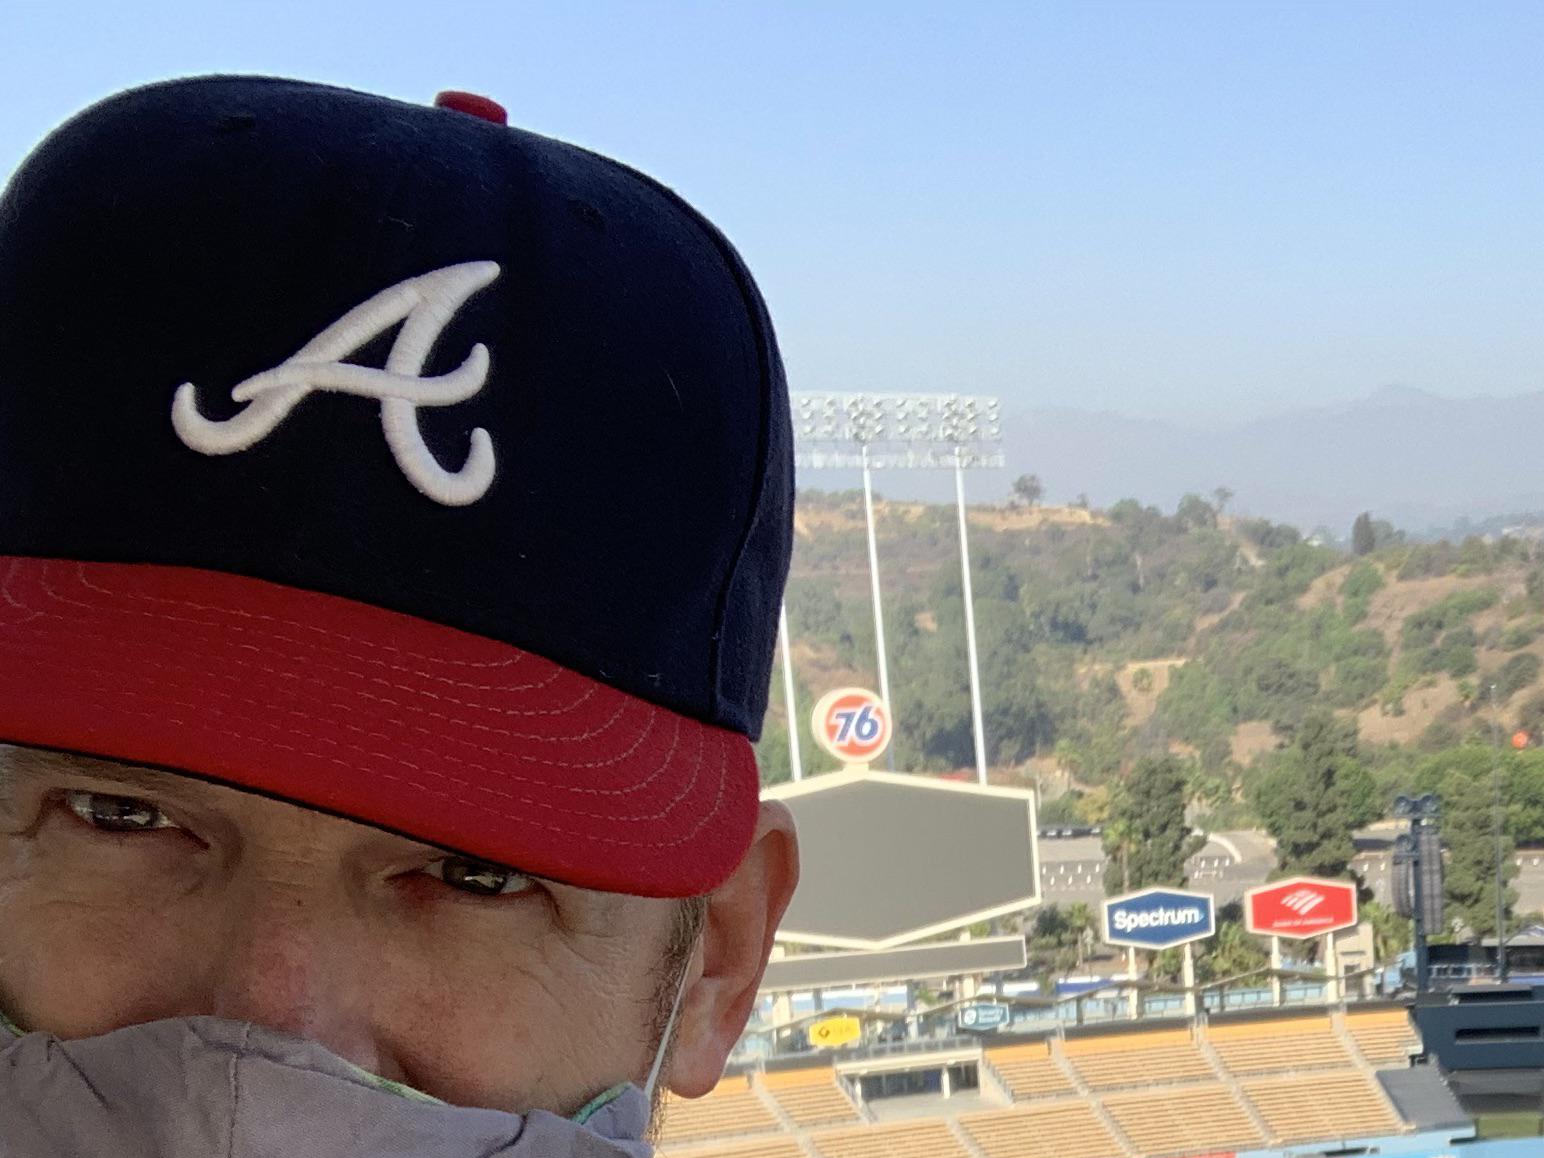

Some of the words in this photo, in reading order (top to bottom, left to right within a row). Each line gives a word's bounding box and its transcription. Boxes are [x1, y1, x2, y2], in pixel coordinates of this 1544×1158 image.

[171, 259, 502, 507] A
[832, 706, 881, 745] 76
[1113, 905, 1201, 933] Spectrum
